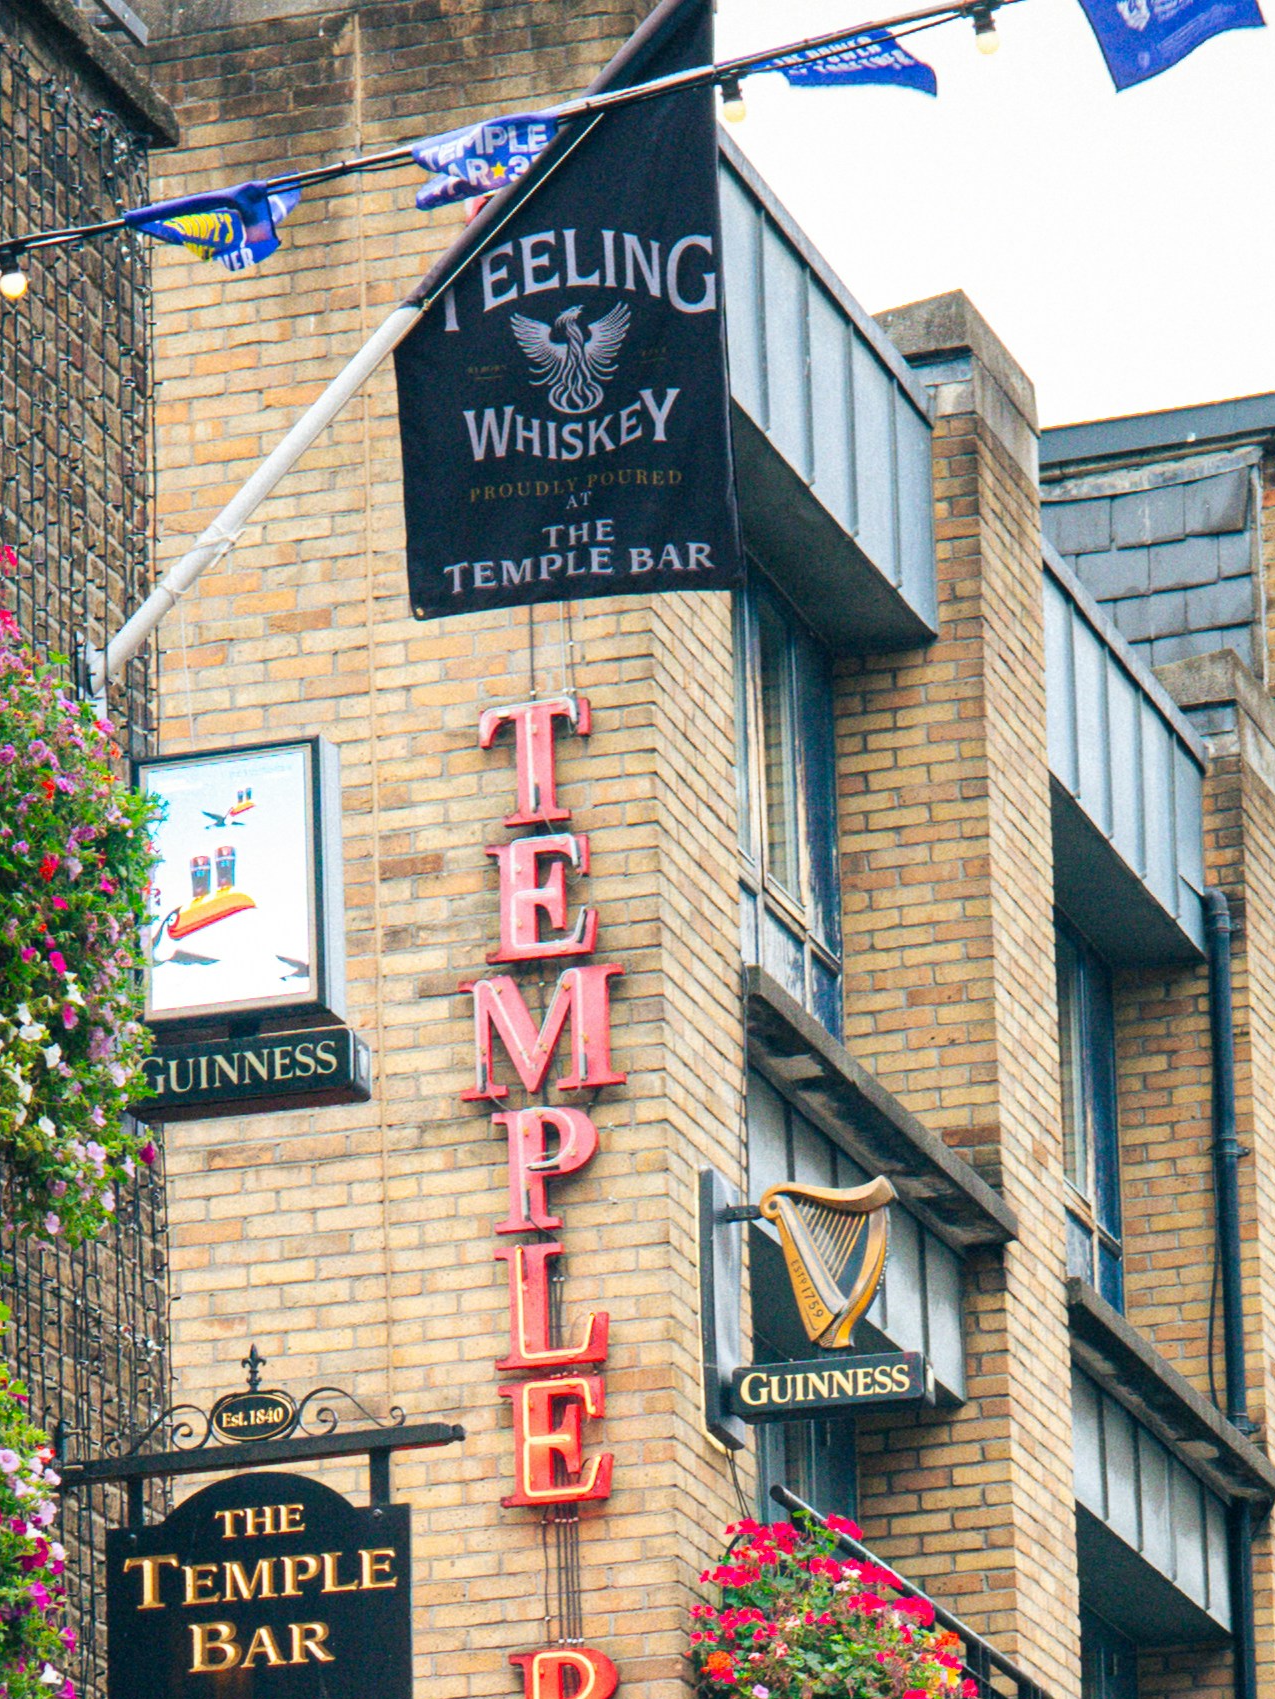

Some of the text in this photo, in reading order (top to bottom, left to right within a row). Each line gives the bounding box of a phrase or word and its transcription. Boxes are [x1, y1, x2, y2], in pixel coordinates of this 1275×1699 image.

[419, 124, 553, 173] TEMPLE
[462, 388, 680, 461] WHISKEY
[469, 469, 683, 502] PROUDLY POURED
[565, 490, 592, 509] AT
[541, 519, 615, 549] THE
[443, 541, 715, 595] TEMPLE BAR
[139, 1040, 339, 1095] GUINNESS
[459, 695, 627, 1508] TEMPLE
[801, 1287, 824, 1319] 1759
[740, 1364, 911, 1406] GUINNESS
[215, 1504, 306, 1540] THE
[123, 1548, 399, 1611] TEMPLE
[188, 1621, 335, 1673] BAR
